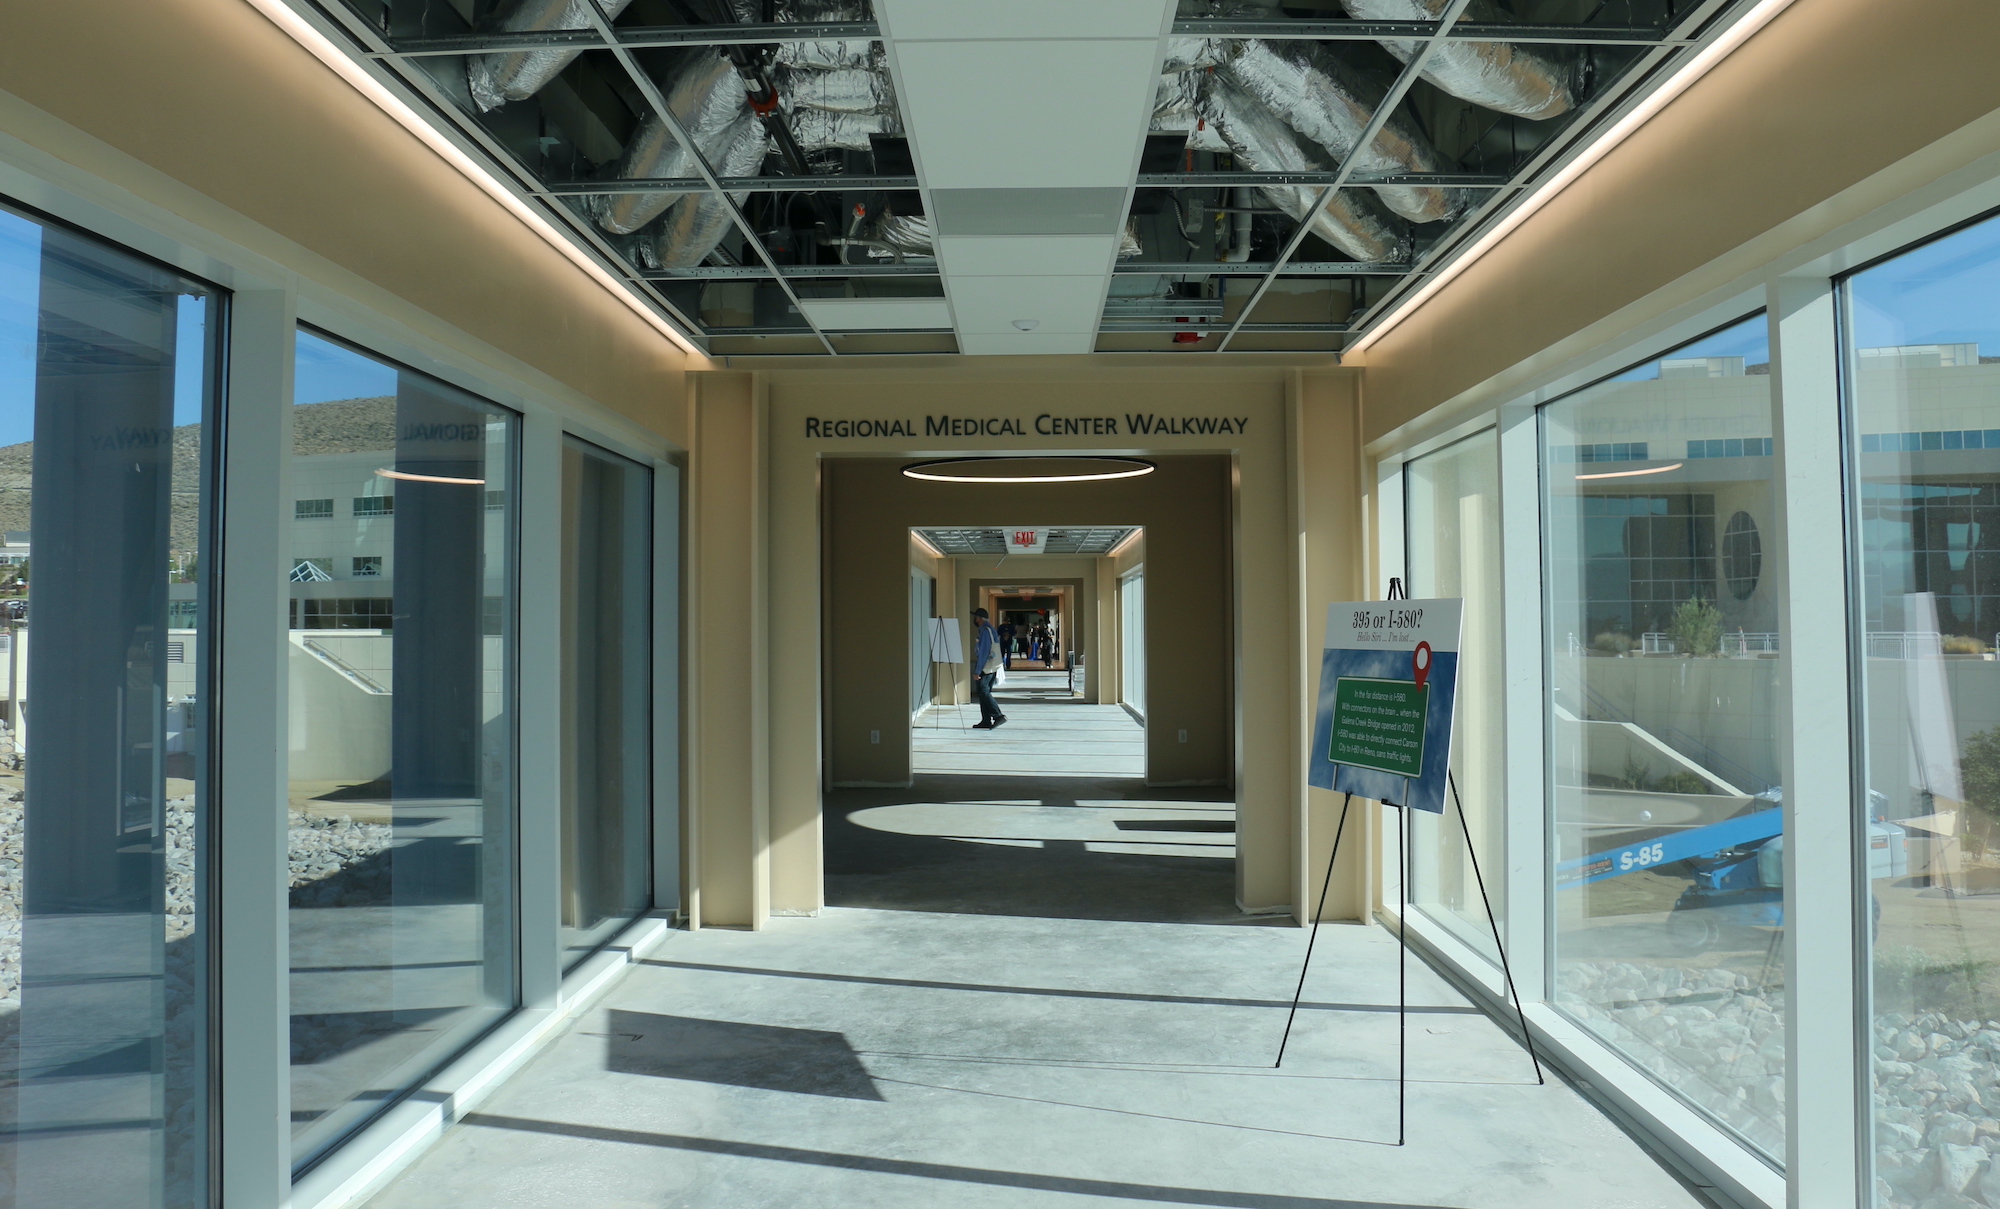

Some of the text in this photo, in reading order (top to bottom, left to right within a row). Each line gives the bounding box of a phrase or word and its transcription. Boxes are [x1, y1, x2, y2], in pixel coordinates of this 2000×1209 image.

[805, 414, 1249, 438] REGIONAL MEDICAL CENTER WALKWAY
[1016, 532, 1034, 544] EXIT
[1352, 608, 1423, 628] 395 or I-580?
[1356, 632, 1370, 642] Hello
[1372, 691, 1388, 700] distance
[1389, 693, 1393, 701] is
[1342, 702, 1350, 711] With
[1351, 704, 1371, 713] connectors
[1400, 709, 1411, 718] when
[1342, 716, 1355, 725] Galena
[1356, 717, 1367, 726] Creek
[1367, 719, 1380, 730] Bridge
[1381, 721, 1397, 731] opened
[1357, 732, 1365, 740] able
[1371, 734, 1384, 745] directly
[1385, 738, 1402, 746] connect
[1402, 738, 1418, 748] Carson
[1387, 751, 1398, 760] traffic
[1620, 842, 1664, 870] S-85
